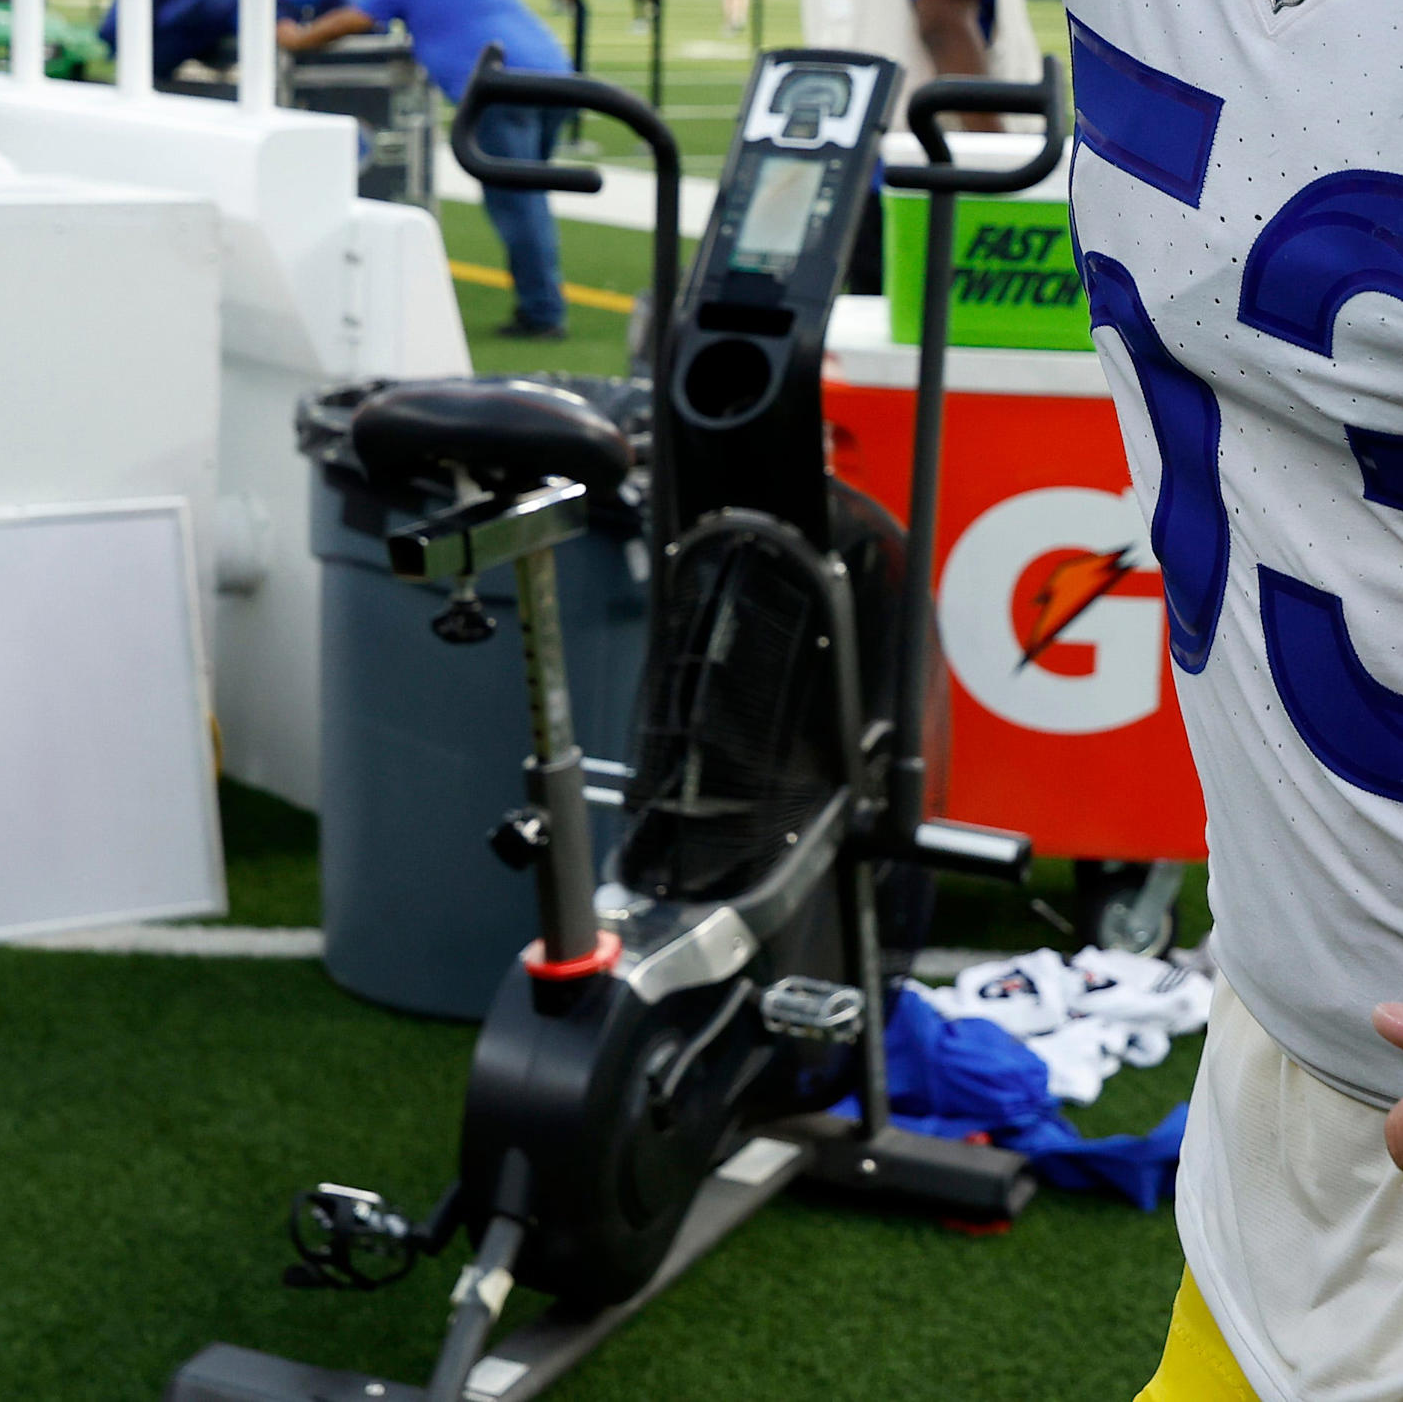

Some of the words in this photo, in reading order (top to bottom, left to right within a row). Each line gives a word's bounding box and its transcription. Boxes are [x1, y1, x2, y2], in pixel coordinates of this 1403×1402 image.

[965, 224, 1065, 265] FAST
[951, 267, 1082, 309] TWITCH
[938, 485, 1167, 735] G
